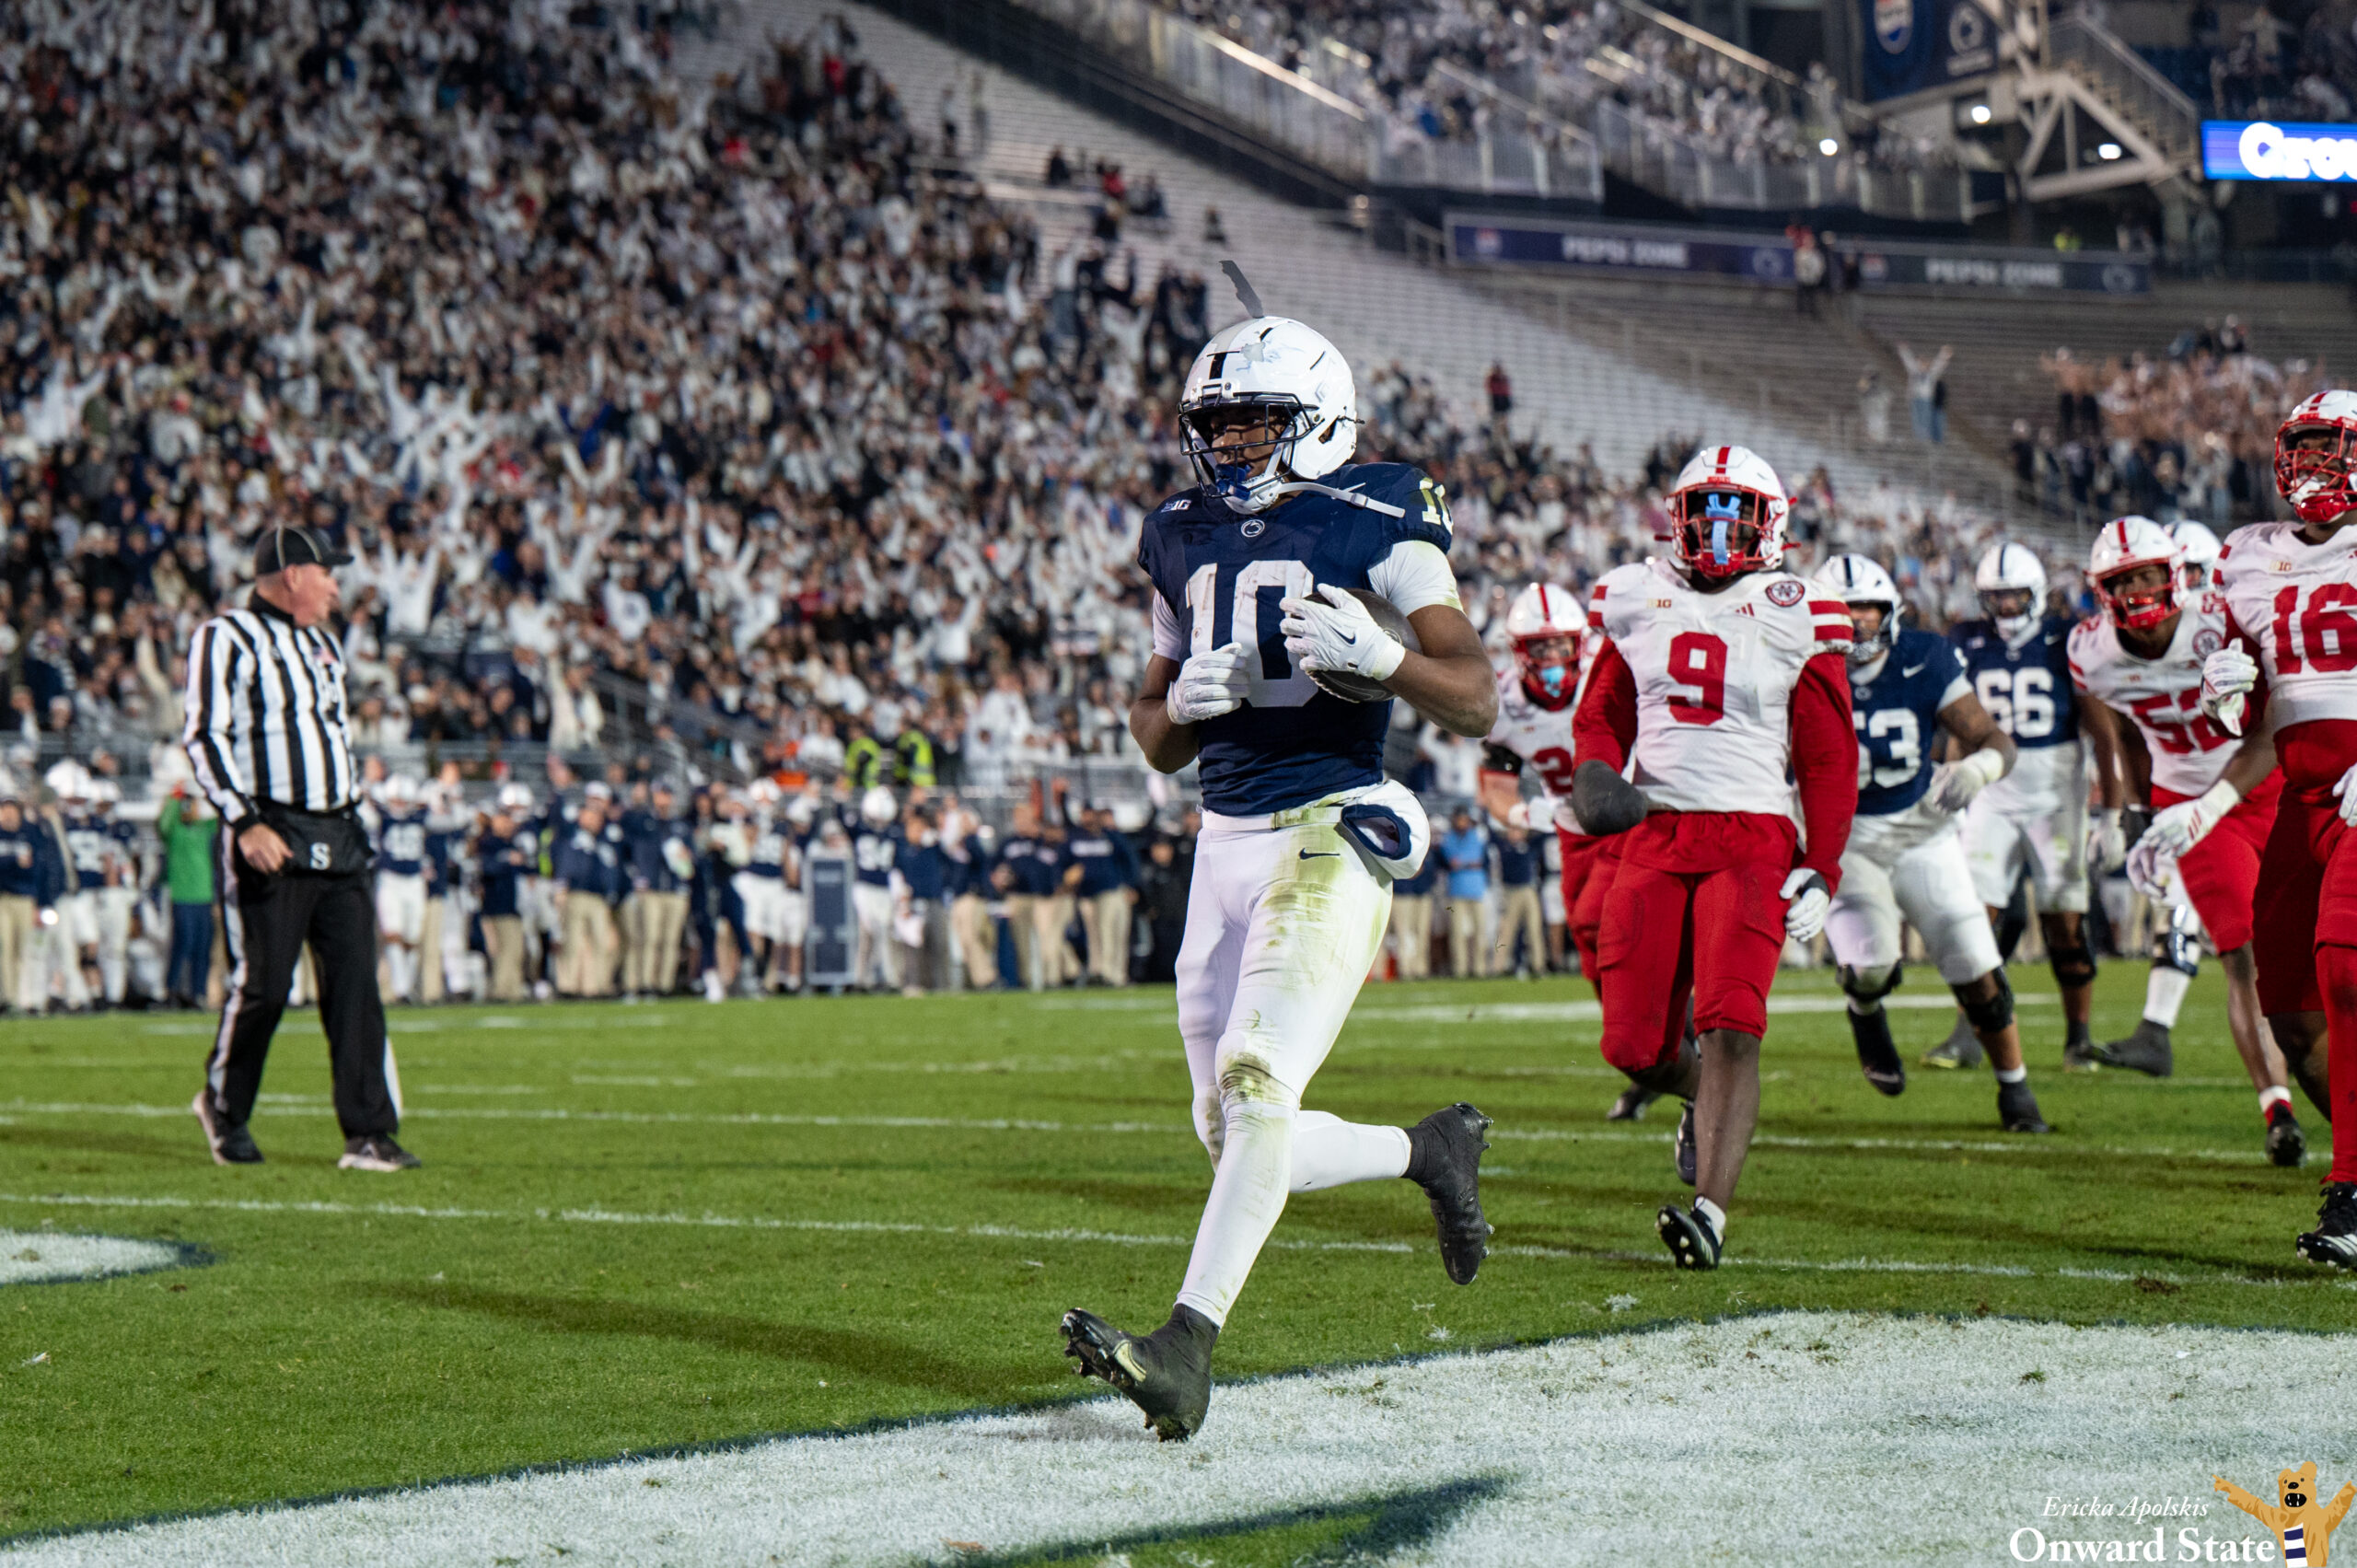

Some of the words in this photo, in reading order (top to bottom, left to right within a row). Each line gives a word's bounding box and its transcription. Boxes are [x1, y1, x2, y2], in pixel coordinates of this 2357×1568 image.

[1562, 236, 1628, 263] PEPSI
[1633, 240, 1689, 268] ZONE
[1926, 259, 1996, 285] PEPSI
[2002, 262, 2062, 288] ZONE
[1185, 560, 1318, 708] 10
[2271, 582, 2357, 675] 16
[1666, 631, 1728, 727] 9
[1976, 667, 2055, 738] 66
[309, 842, 331, 871] S
